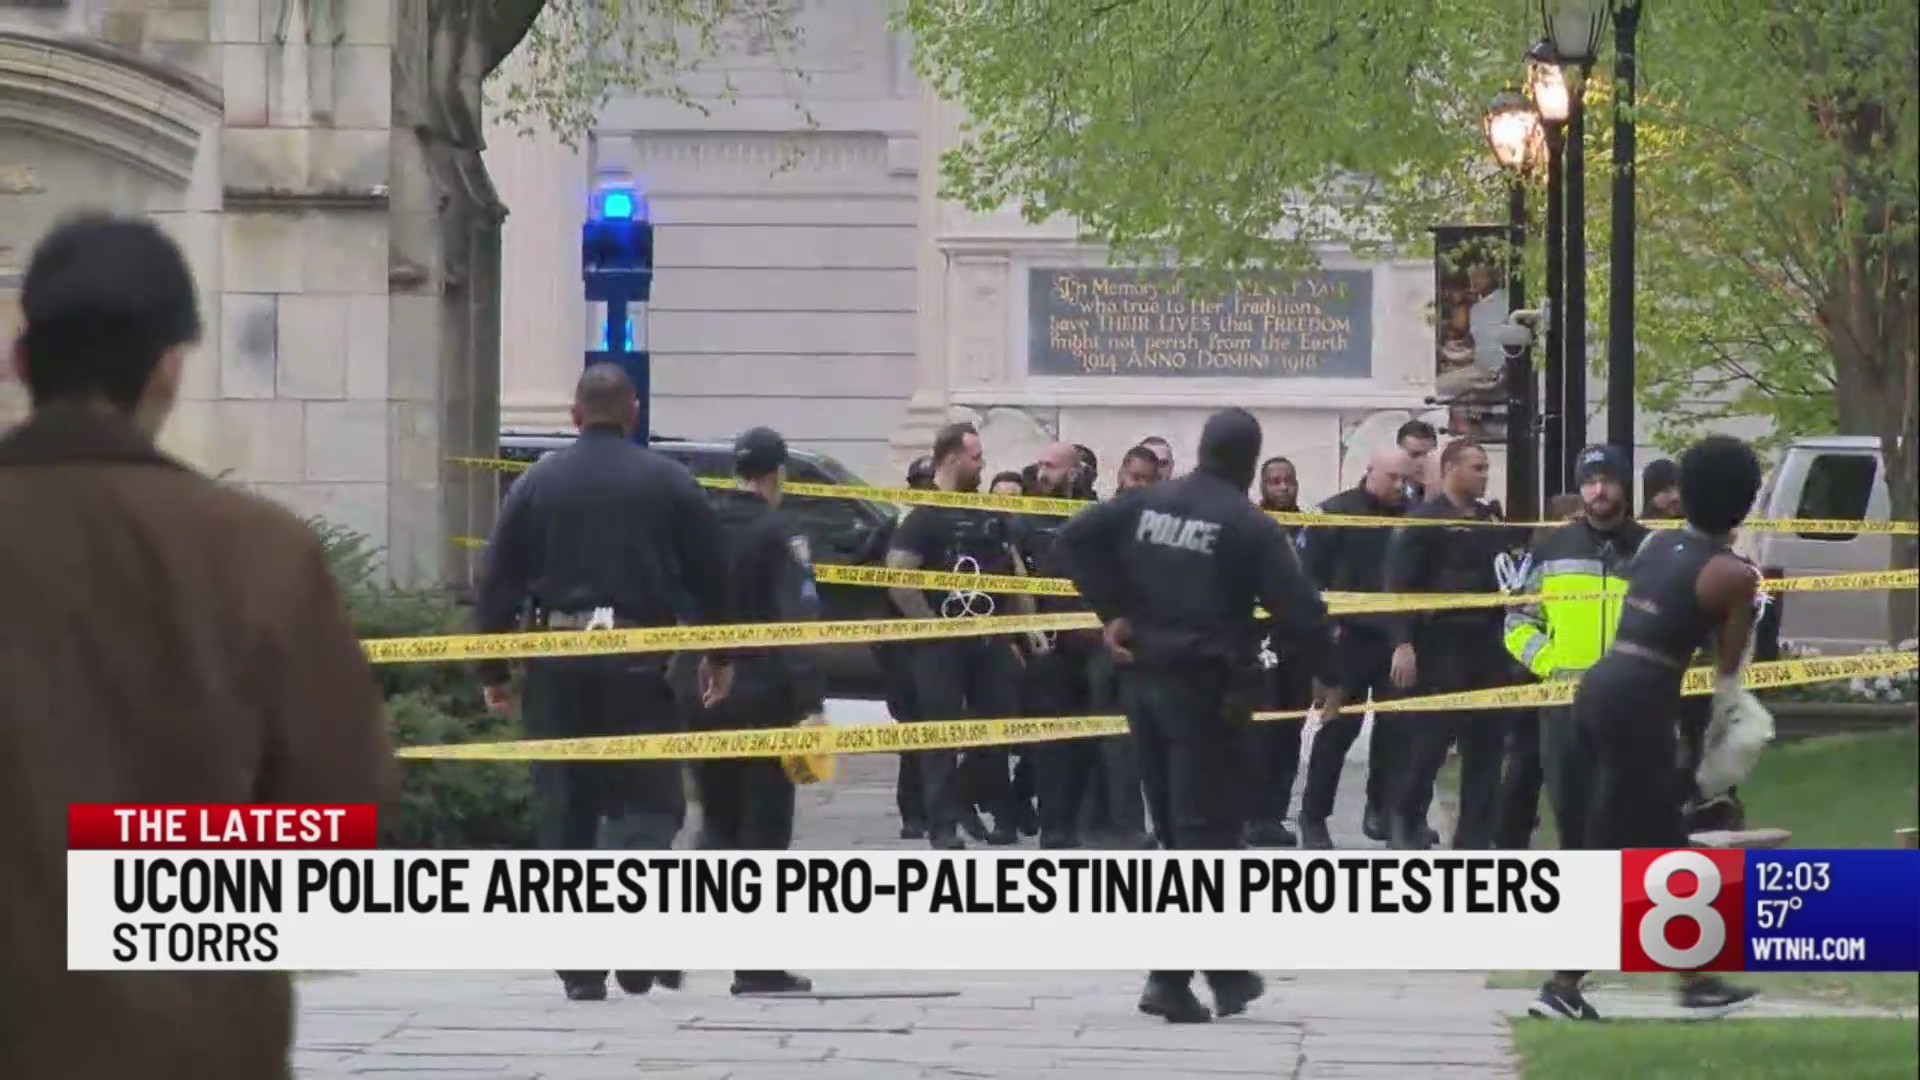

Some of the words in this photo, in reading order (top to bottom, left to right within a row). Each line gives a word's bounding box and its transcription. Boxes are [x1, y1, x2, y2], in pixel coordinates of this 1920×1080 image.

[1080, 295, 1117, 314] who
[1123, 299, 1159, 314] true
[1167, 299, 1185, 314] to
[1191, 298, 1222, 314] Her
[1100, 315, 1149, 332] THEIR
[1159, 314, 1210, 332] LIVES
[1219, 314, 1254, 333] that
[1263, 315, 1350, 333] FREEDOM
[1108, 336, 1136, 350] not
[1145, 332, 1198, 354] perish
[1210, 332, 1251, 350] from
[1261, 332, 1290, 350] the
[1301, 333, 1347, 350] Earth
[1082, 353, 1117, 373] 1914
[1127, 350, 1186, 369] ANNO
[1198, 350, 1269, 369] DOMINI
[1137, 509, 1221, 554] POLICE
